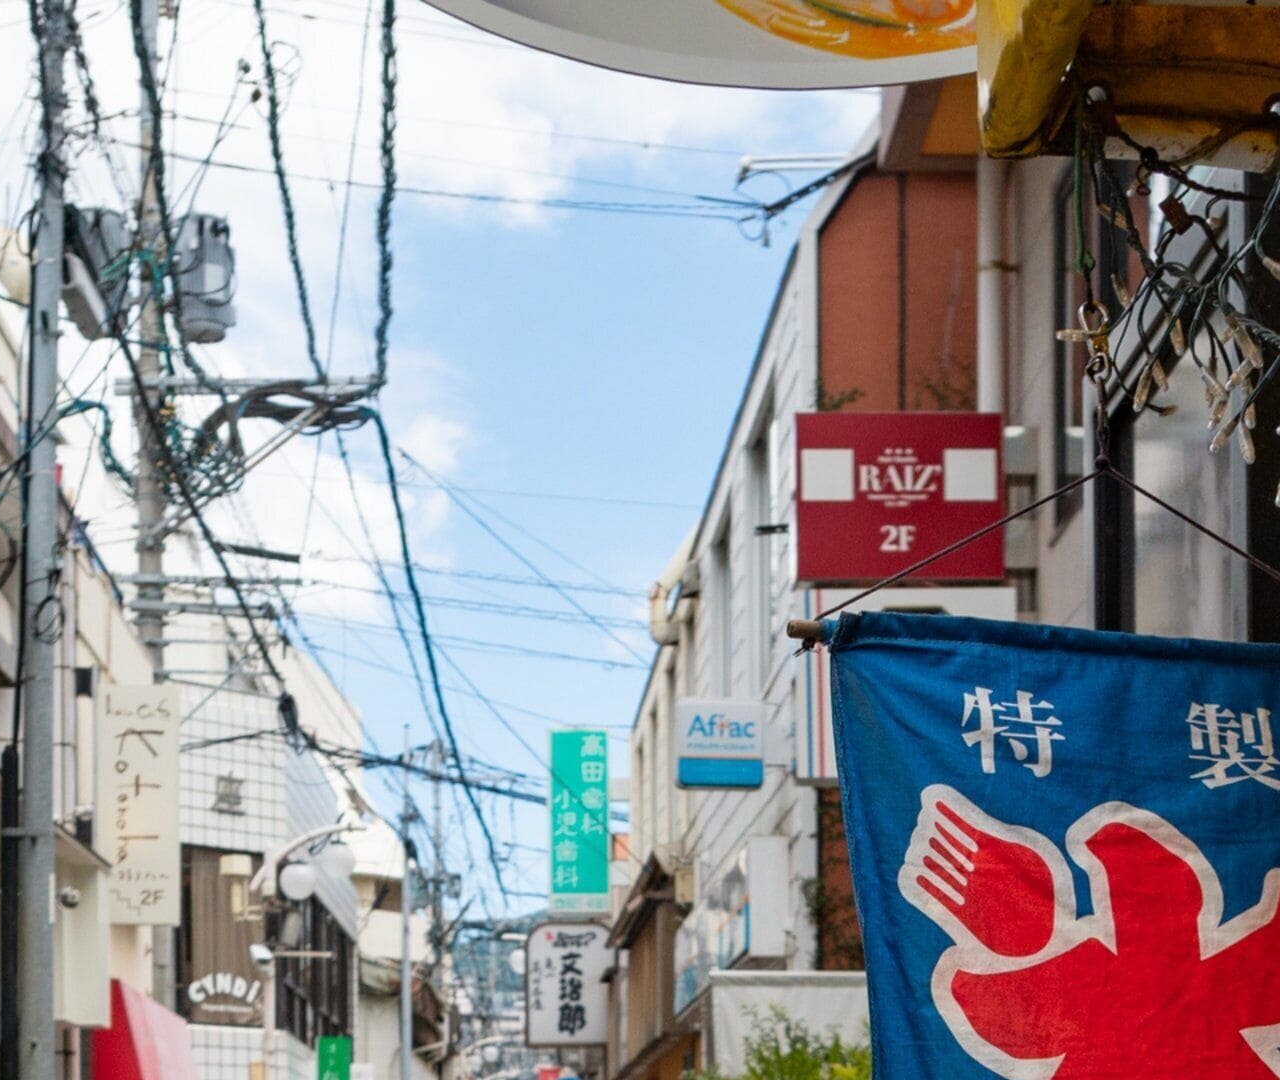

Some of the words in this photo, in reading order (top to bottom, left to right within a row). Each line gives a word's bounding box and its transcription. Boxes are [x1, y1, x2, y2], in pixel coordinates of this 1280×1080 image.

[859, 464, 942, 493] RAIZ
[880, 524, 916, 553] 2F
[140, 889, 163, 906] 2F
